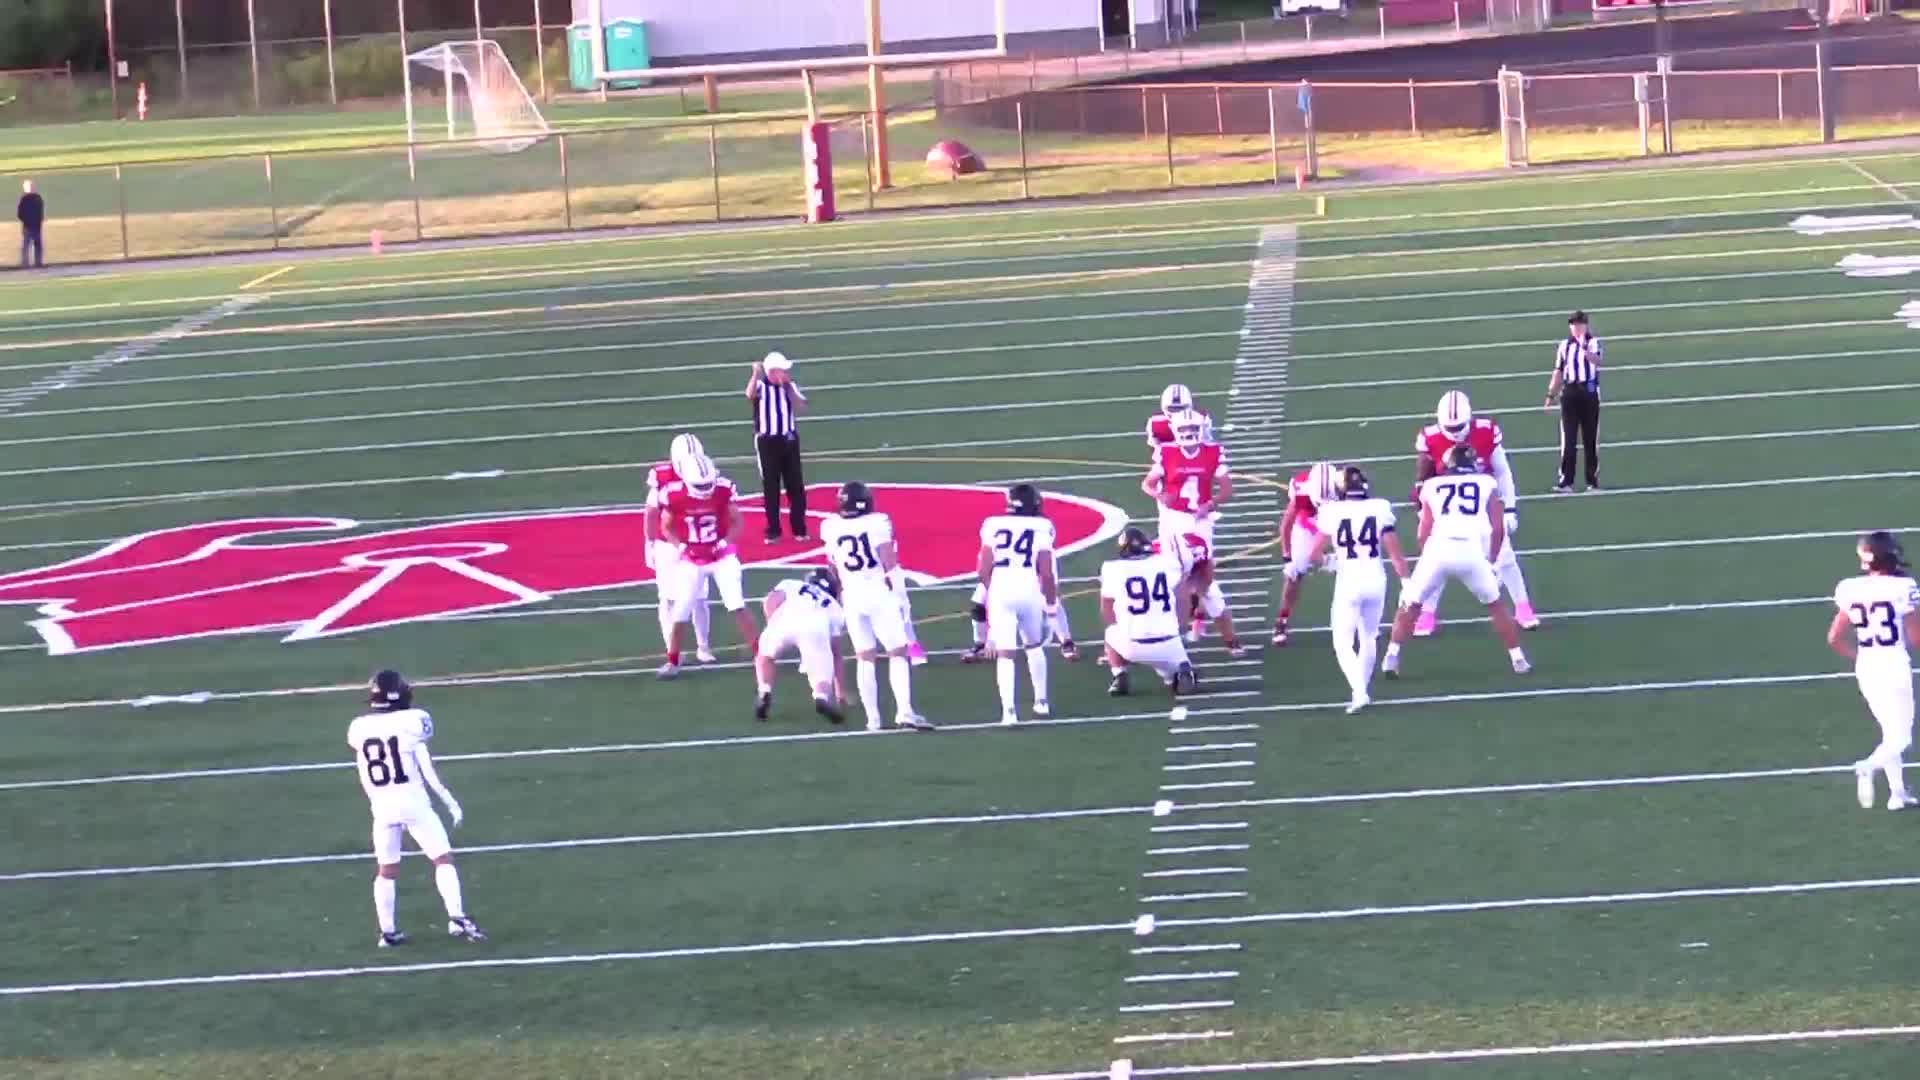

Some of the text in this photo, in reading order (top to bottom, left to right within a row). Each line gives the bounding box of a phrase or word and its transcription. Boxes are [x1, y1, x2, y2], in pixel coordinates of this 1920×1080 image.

[1180, 475, 1201, 510] 4
[1436, 482, 1481, 516] 79
[684, 514, 717, 543] 12
[994, 529, 1034, 568] 24
[1337, 516, 1379, 559] 44
[837, 531, 880, 572] 31
[1126, 572, 1172, 616] 94
[1850, 601, 1900, 647] 23
[363, 735, 409, 787] 81
